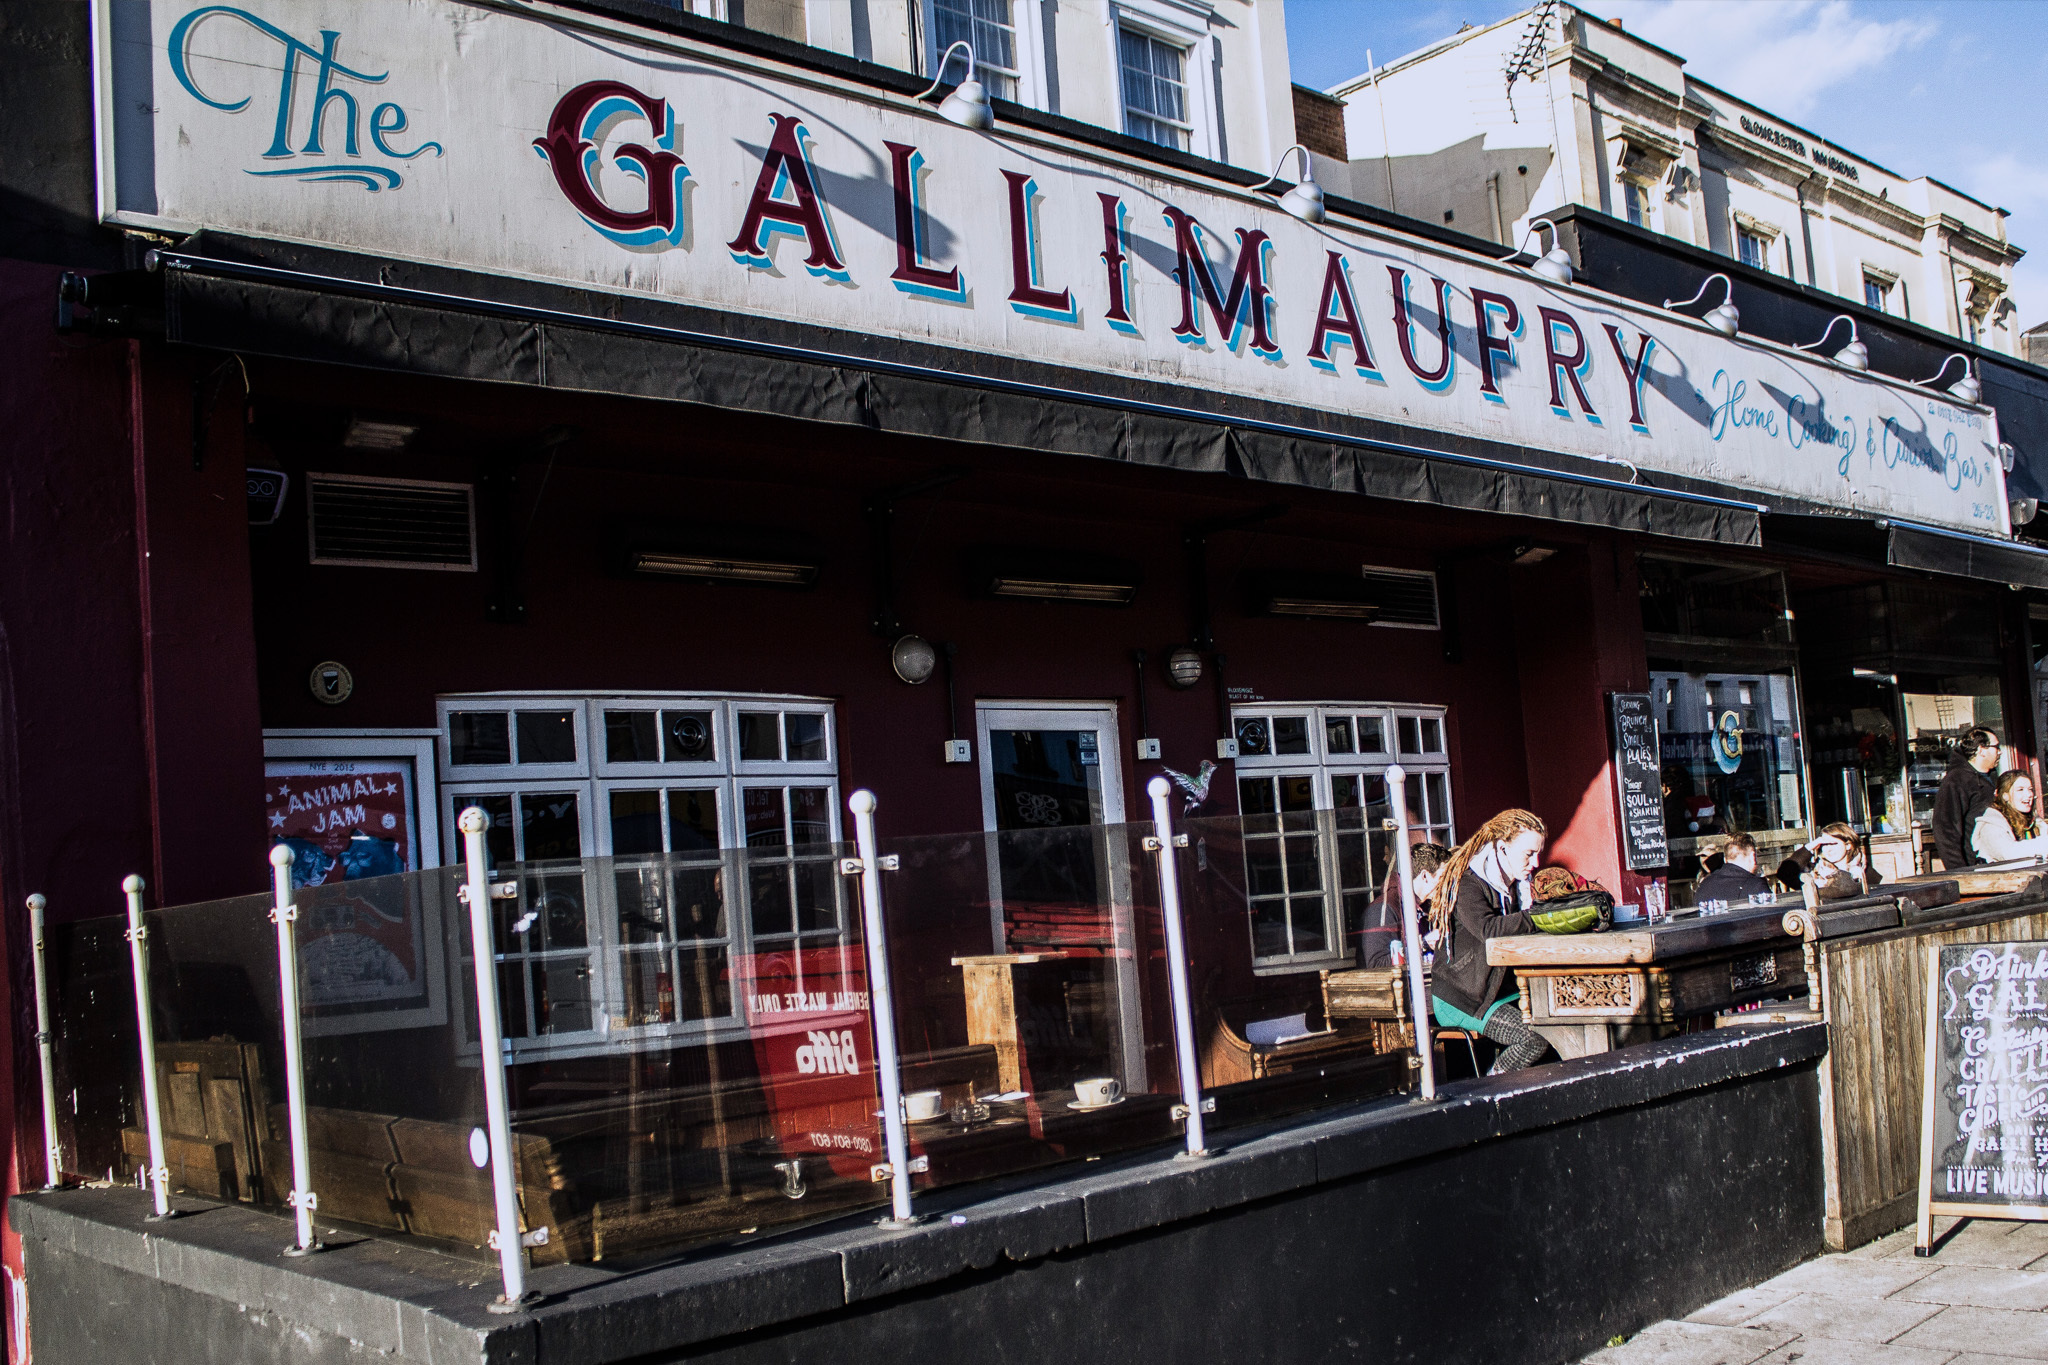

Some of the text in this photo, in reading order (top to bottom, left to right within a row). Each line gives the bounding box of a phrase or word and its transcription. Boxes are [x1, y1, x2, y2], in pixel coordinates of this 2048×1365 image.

[167, 5, 445, 162] The
[532, 79, 1657, 437] GALLIMAUFRY
[1709, 369, 1778, 441] Home
[1787, 394, 1856, 476] Cooking
[1866, 417, 1876, 470] &
[1943, 428, 1982, 493] Bar
[1619, 715, 1648, 732] BRUNCH
[1627, 745, 1651, 764] PLATES
[1711, 710, 1743, 775] G
[309, 763, 355, 772] NYE 2015
[287, 776, 383, 814] ANIMAL
[1626, 794, 1650, 808] SOUL
[311, 804, 367, 833] JAM
[1957, 1083, 2021, 1108] TASTY
[1958, 1091, 2047, 1134] CDER AND
[1947, 1169, 1988, 1195] LIVE
